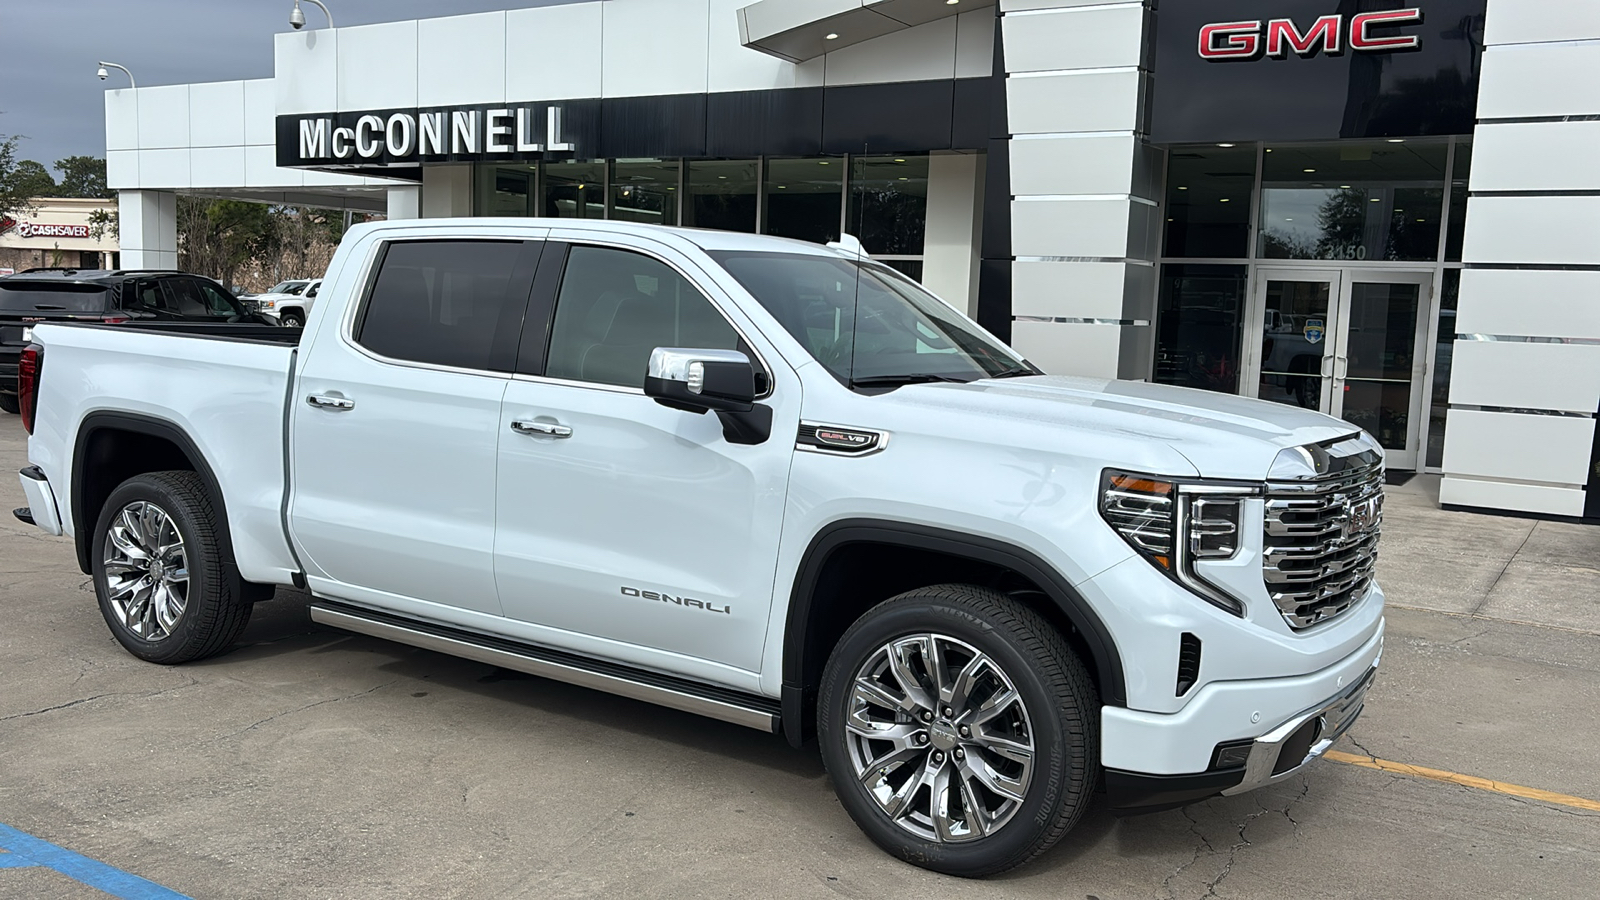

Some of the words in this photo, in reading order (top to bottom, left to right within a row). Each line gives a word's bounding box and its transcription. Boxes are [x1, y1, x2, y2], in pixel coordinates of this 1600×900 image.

[1198, 7, 1422, 59] GMC
[300, 106, 575, 159] McCONNELL
[848, 435, 865, 443] V8
[621, 586, 730, 614] DENALI
[1034, 745, 1062, 827] BRIDGESTONE
